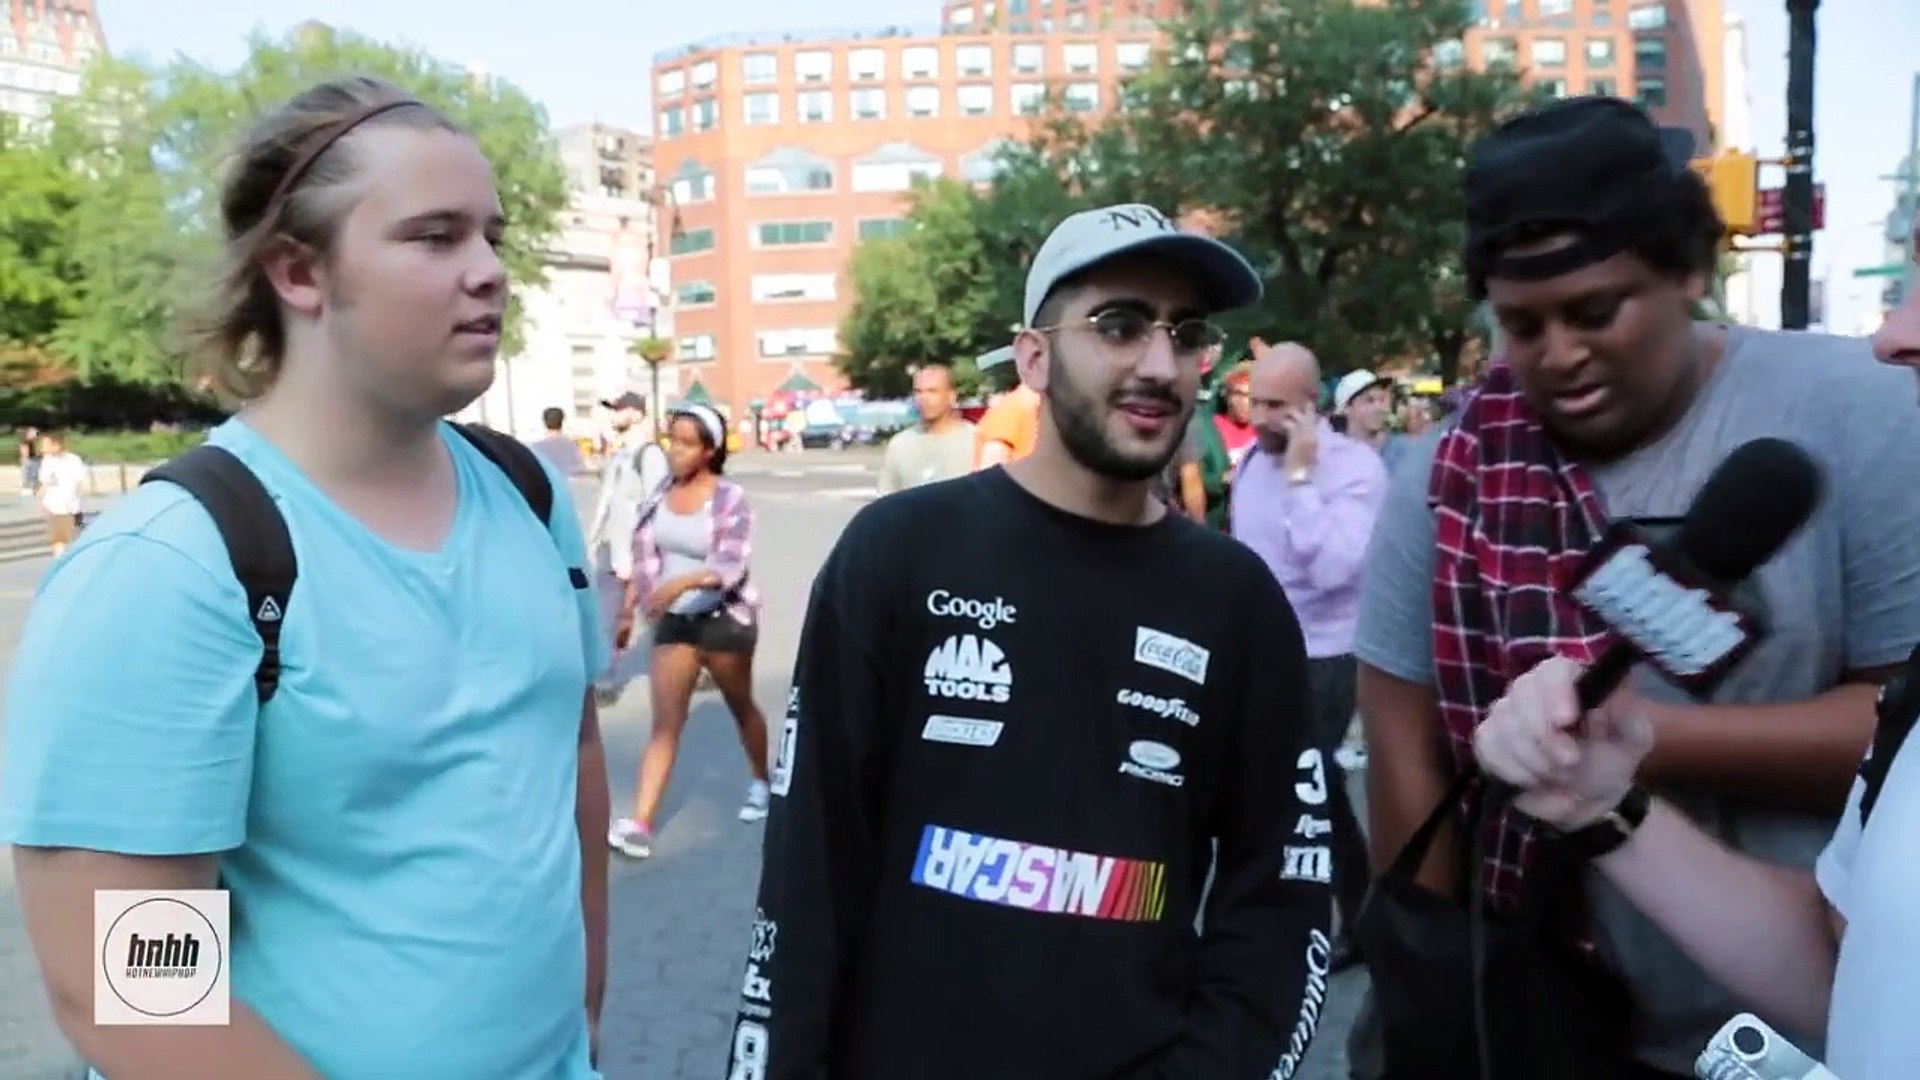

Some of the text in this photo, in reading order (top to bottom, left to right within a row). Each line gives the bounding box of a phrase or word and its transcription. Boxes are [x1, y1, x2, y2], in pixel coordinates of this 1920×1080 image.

[927, 589, 1017, 629] Google
[924, 634, 1012, 685] MAC
[924, 678, 1010, 703] TOOLS
[923, 829, 1114, 918] NASCAR
